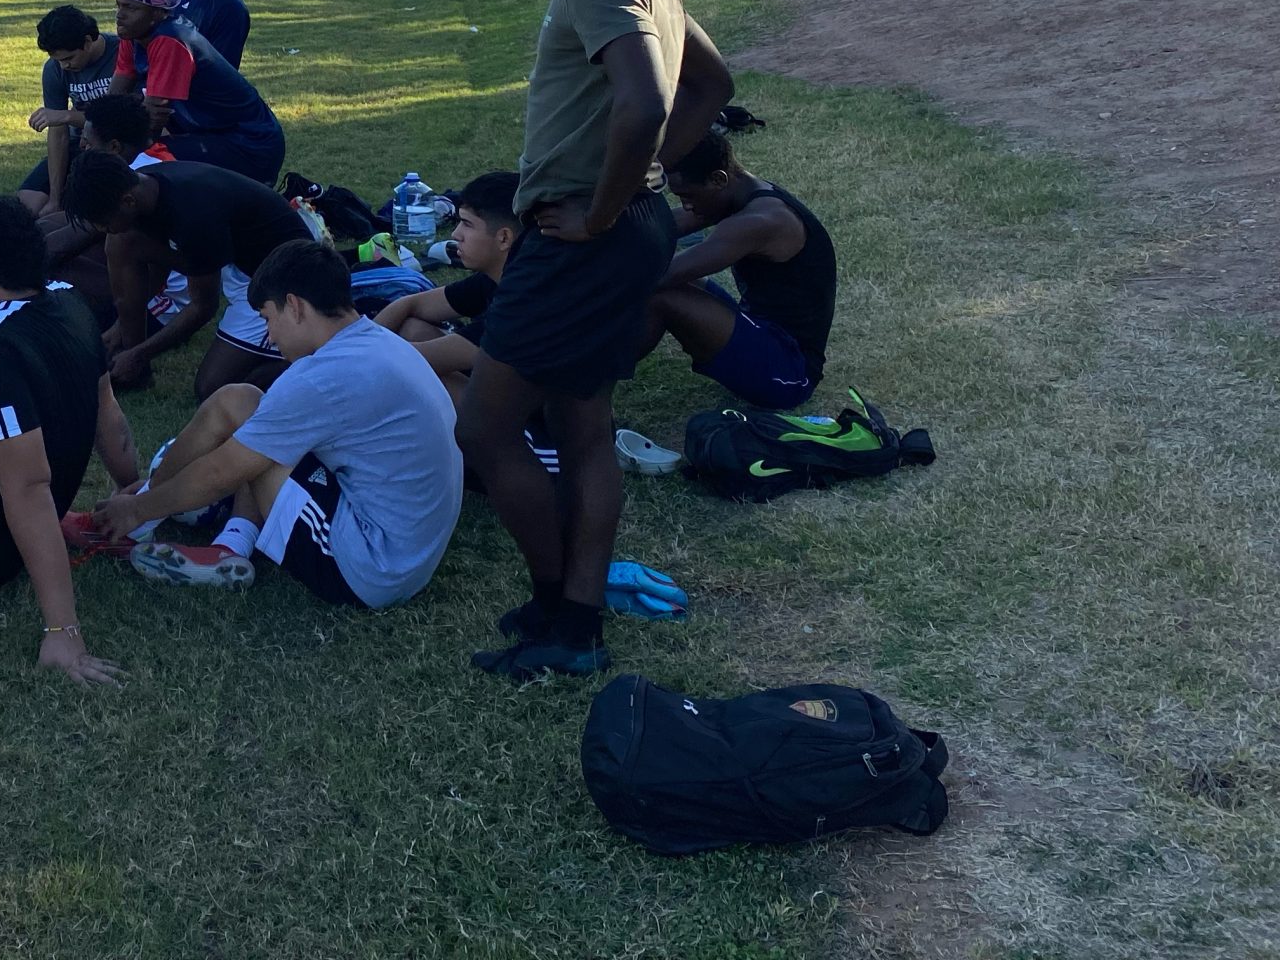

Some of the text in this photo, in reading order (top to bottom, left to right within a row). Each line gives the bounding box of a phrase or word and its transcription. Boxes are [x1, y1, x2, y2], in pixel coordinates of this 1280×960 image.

[70, 77, 112, 93] EAST VALLEY
[80, 87, 109, 102] UNITE
